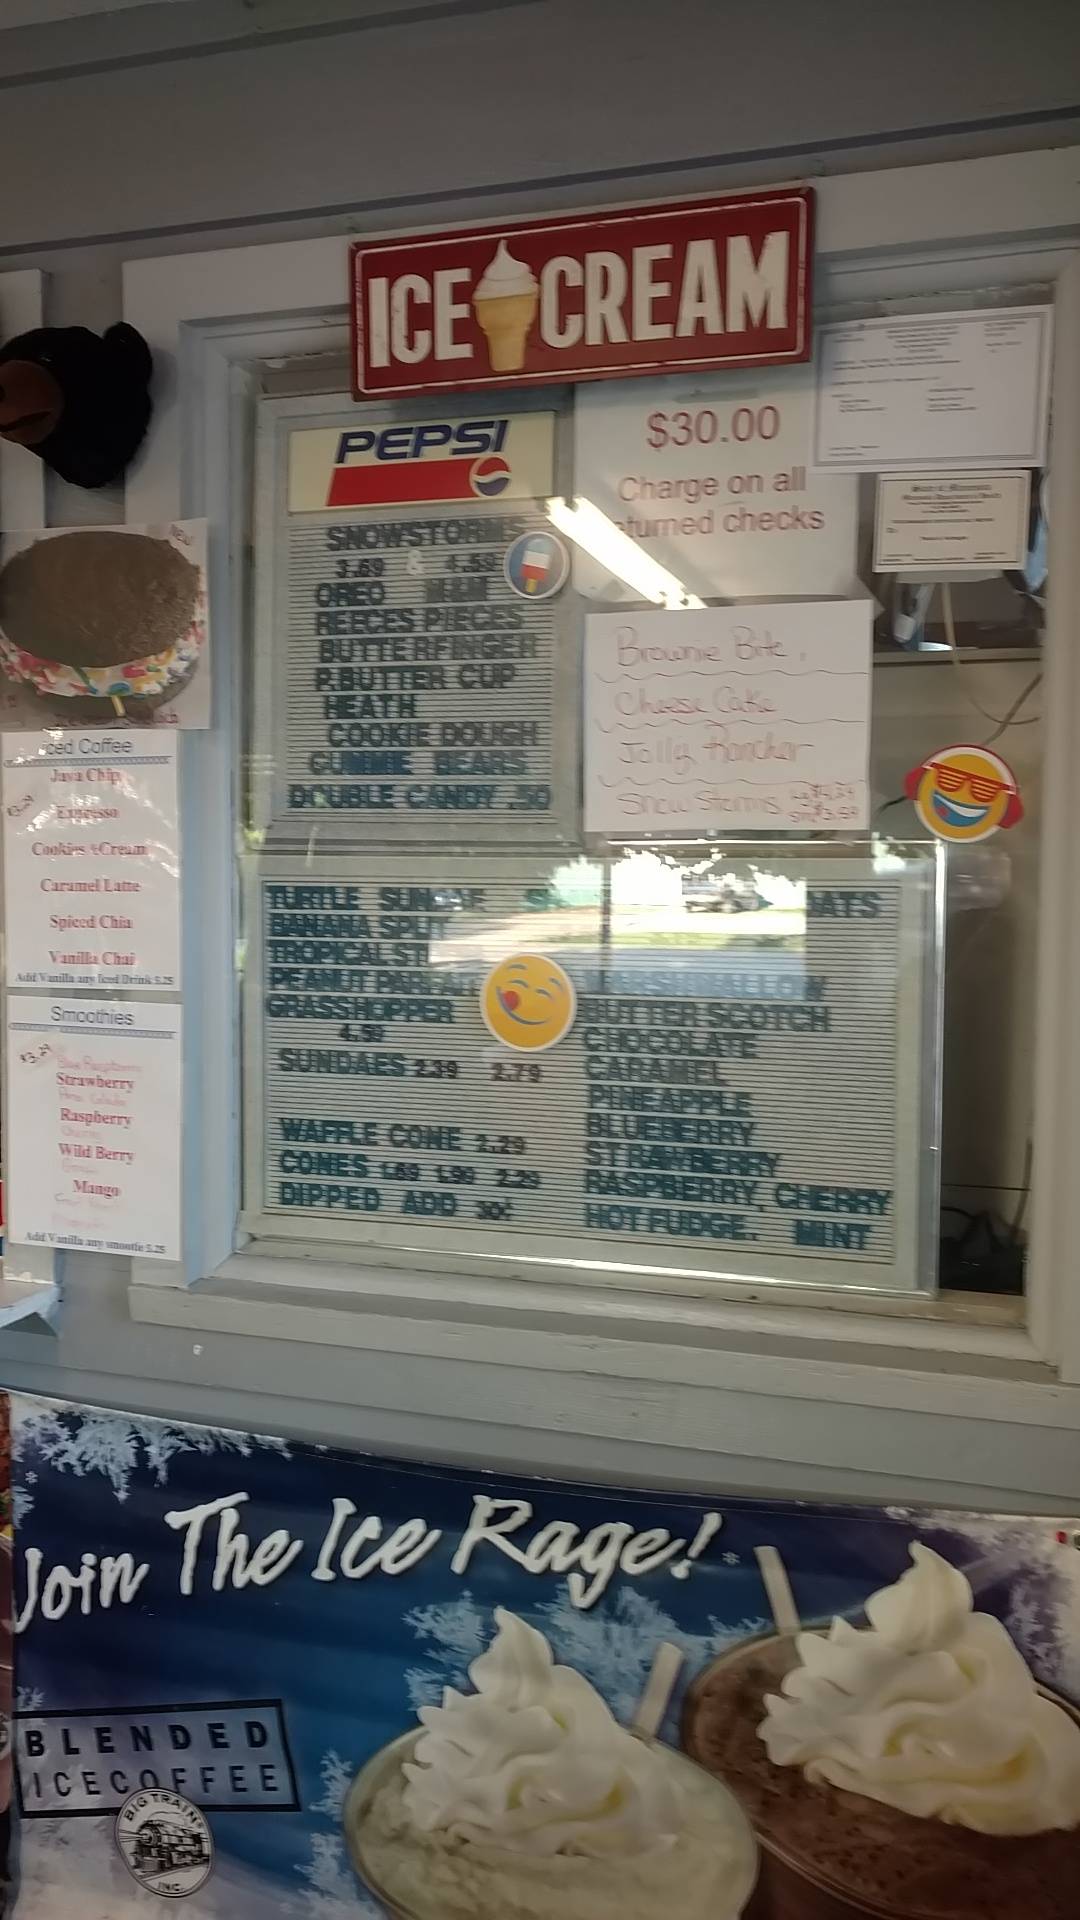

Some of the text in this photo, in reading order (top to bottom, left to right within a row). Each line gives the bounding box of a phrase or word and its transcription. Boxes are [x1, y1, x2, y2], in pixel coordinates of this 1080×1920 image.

[368, 230, 790, 368] ICE CREAM
[646, 404, 780, 449] $30.00
[335, 419, 510, 464] PEPSI
[618, 466, 806, 506] Charge on all
[612, 505, 826, 539] eturned checks
[315, 580, 384, 608] OREO
[315, 603, 524, 636] REECES PIECES
[319, 632, 537, 664] BUTTERFINGER
[615, 626, 722, 668] Brownie
[457, 663, 517, 689] CUP
[324, 693, 417, 719] HEATH
[712, 685, 778, 715] Cake
[79, 738, 134, 755] Coffee
[328, 720, 538, 748] COOKIE DOUGH
[434, 749, 528, 776] BEARS
[618, 733, 696, 776] Jolly
[50, 768, 121, 785] Java Chip
[289, 784, 396, 810] DOUBLE
[407, 783, 500, 809] CANDY
[616, 792, 690, 815] Snow
[32, 842, 86, 857] Cookies
[40, 878, 142, 893] Caramel Latte
[266, 885, 360, 911] TURTLE
[49, 914, 96, 931] Spiced
[269, 913, 371, 938] BANANA
[48, 950, 136, 966] Vanilla Chai
[15, 973, 36, 984] Add
[39, 972, 76, 984] Vanilla
[78, 975, 95, 985] any
[98, 973, 119, 984] Iced
[269, 967, 368, 993] PEANUT
[50, 1006, 135, 1026] Smoothies
[266, 995, 830, 1032] GRASSHOPPER BUTTER SCOTCH
[584, 1027, 758, 1059] CHOCOLATE
[278, 1048, 407, 1077] SUNDAES
[491, 1063, 543, 1083] 2.79
[584, 1055, 729, 1087] CARAMEL
[55, 1072, 135, 1094] Strawberry
[587, 1083, 753, 1117] PINEAPPLE
[60, 1107, 133, 1130] Raspberry
[587, 1113, 756, 1146] BLUEBERRY
[279, 1117, 379, 1147] WAFFLE
[388, 1123, 463, 1152] CONE
[58, 1143, 135, 1166] Wild Berry
[279, 1149, 370, 1178] CONES
[72, 1179, 121, 1199] Mango
[279, 1182, 381, 1212] DIPPED
[402, 1189, 458, 1218] ADD
[774, 1182, 893, 1216] CHERRY
[24, 1231, 46, 1244] Add
[47, 1233, 84, 1248] Vanilla
[85, 1239, 103, 1250] any
[584, 1202, 641, 1230] HOT
[794, 1218, 872, 1250] MINT
[13, 1491, 724, 1634] Join The Ice Rage!
[24, 1720, 269, 1758] BLENDED
[32, 1763, 280, 1799] ICECOFFEE
[124, 1793, 199, 1825] BIG TRAIN
[157, 1881, 186, 1902] INC.
